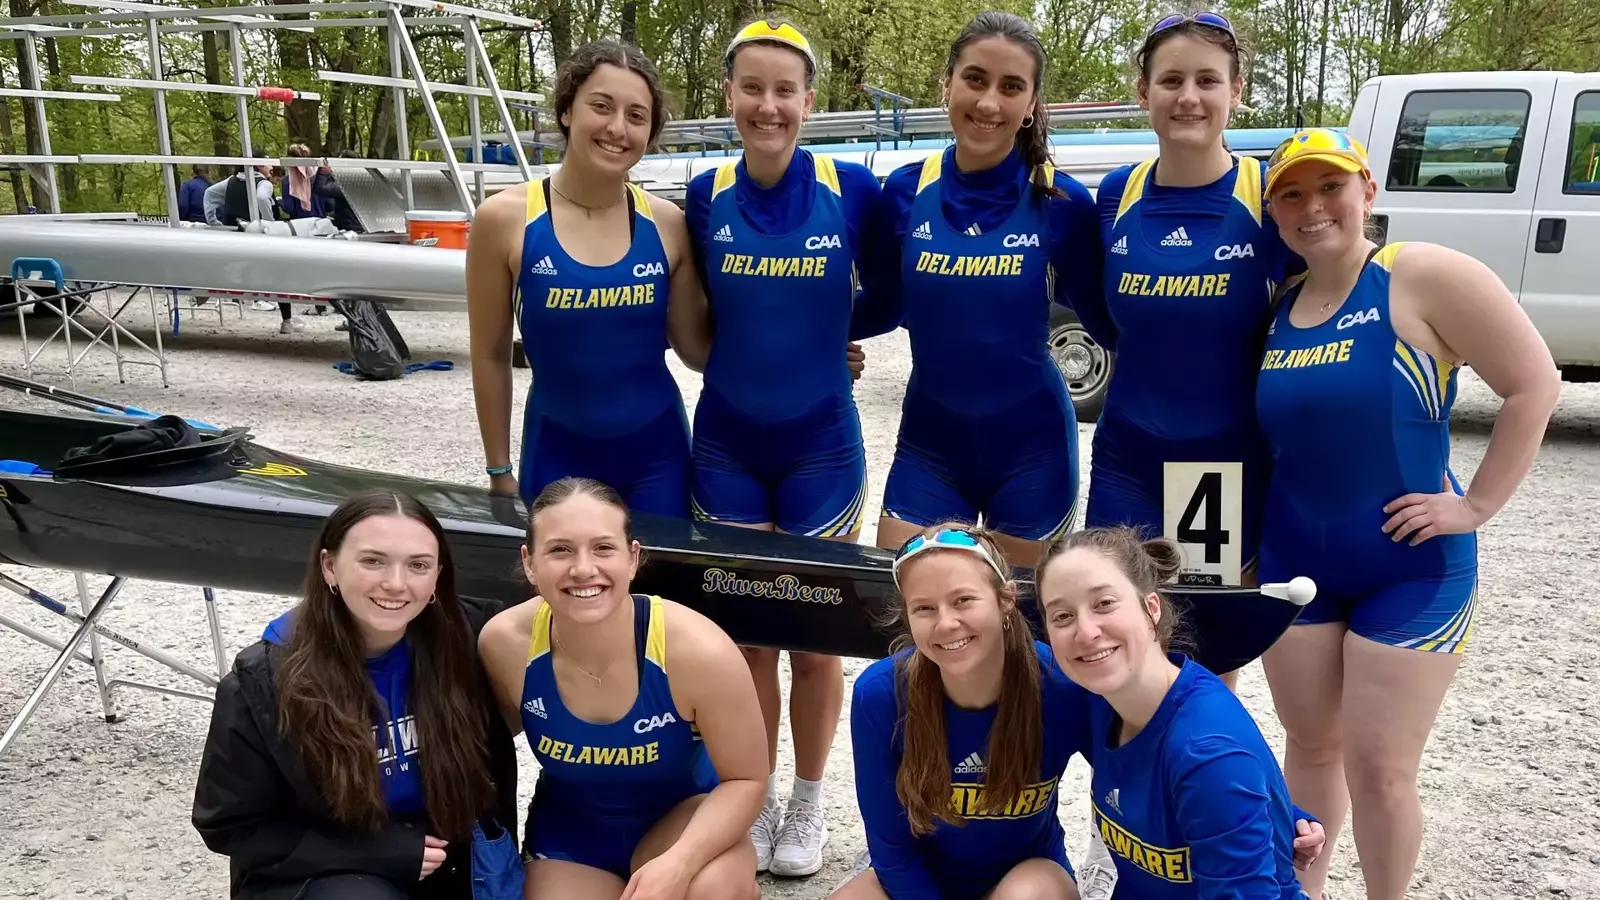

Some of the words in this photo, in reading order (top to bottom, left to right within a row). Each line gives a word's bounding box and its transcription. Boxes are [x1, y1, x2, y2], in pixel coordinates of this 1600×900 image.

[713, 233, 734, 243] adidas
[804, 234, 842, 250] CAA
[912, 230, 933, 241] adidas
[1002, 233, 1040, 248] CAA
[1160, 238, 1193, 247] adidas
[1214, 243, 1255, 261] CAA
[531, 265, 558, 276] adidas
[632, 261, 665, 278] CAA
[721, 253, 828, 277] DELAWARE
[915, 251, 1024, 276] DELAWARE
[1117, 271, 1231, 297] DELAWARE
[545, 283, 655, 309] DELAWARE
[1336, 307, 1381, 330] CAA
[1260, 338, 1355, 371] DELAWARE
[1177, 472, 1230, 564] 4
[701, 567, 843, 605] RiverBear
[523, 703, 548, 720] adidas
[633, 712, 677, 734] CAA
[537, 734, 660, 766] DELAWARE
[1100, 817, 1185, 880] AWARE
